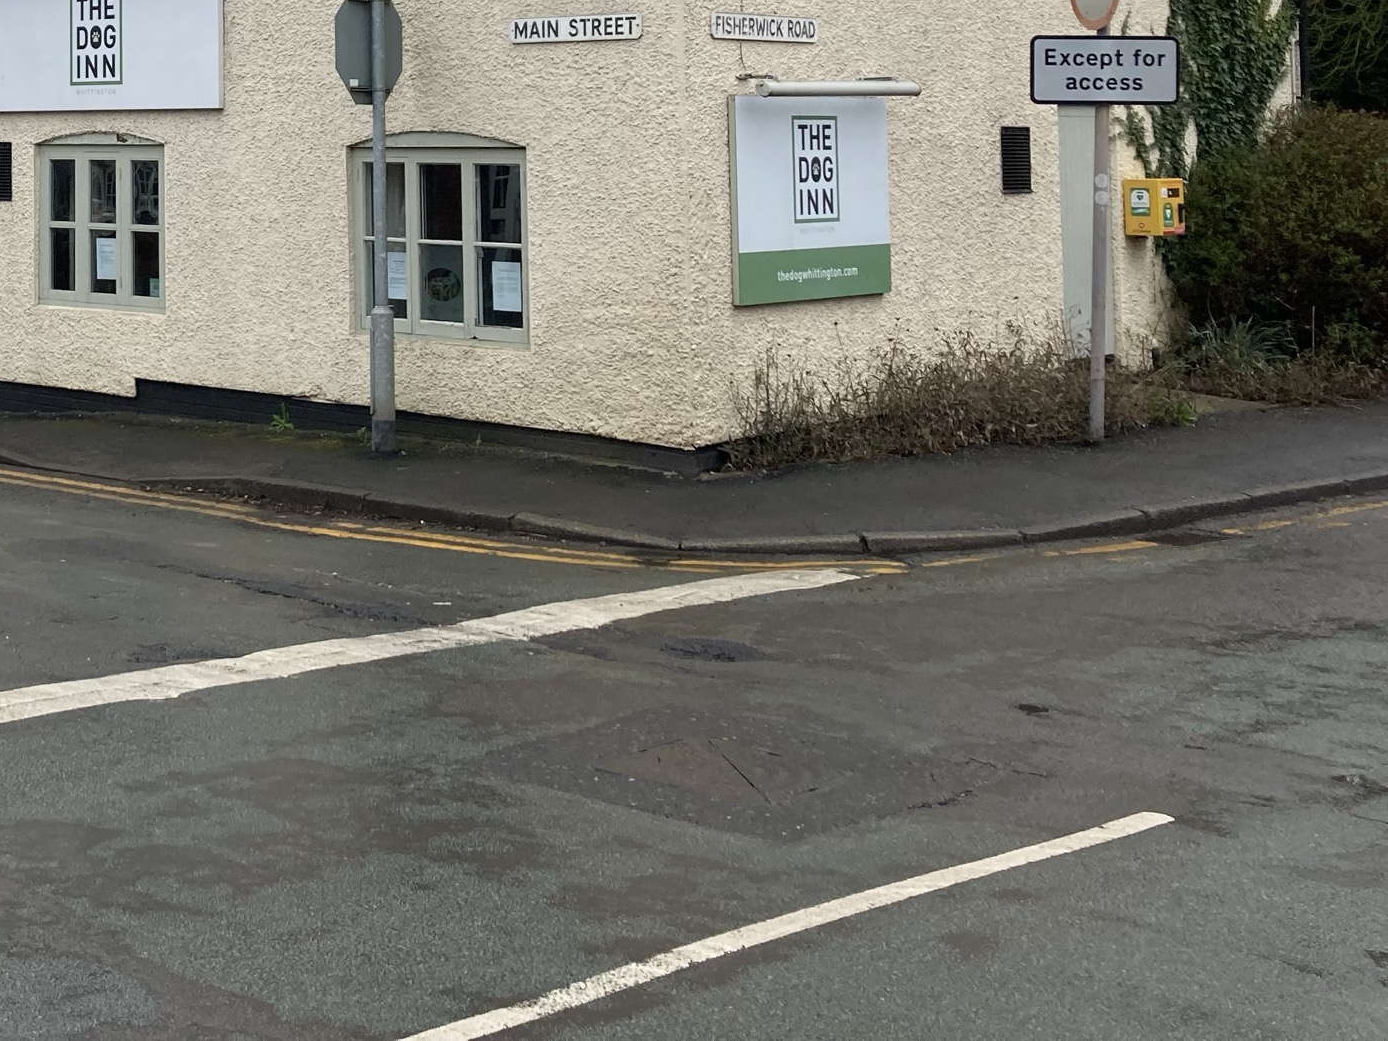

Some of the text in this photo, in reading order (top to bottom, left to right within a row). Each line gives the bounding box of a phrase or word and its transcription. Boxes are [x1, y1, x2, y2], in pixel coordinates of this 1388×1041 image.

[76, 24, 117, 50] DOG
[514, 16, 637, 39] MAIN STREET
[715, 15, 816, 39] FISHERWICK ROAD
[76, 53, 116, 79] INN
[1044, 48, 1166, 70] Except for
[1065, 76, 1144, 91] access
[797, 124, 832, 151] THE
[798, 156, 834, 183] DOG
[799, 188, 834, 216] INN
[777, 266, 859, 283] thedogwhittington.com
